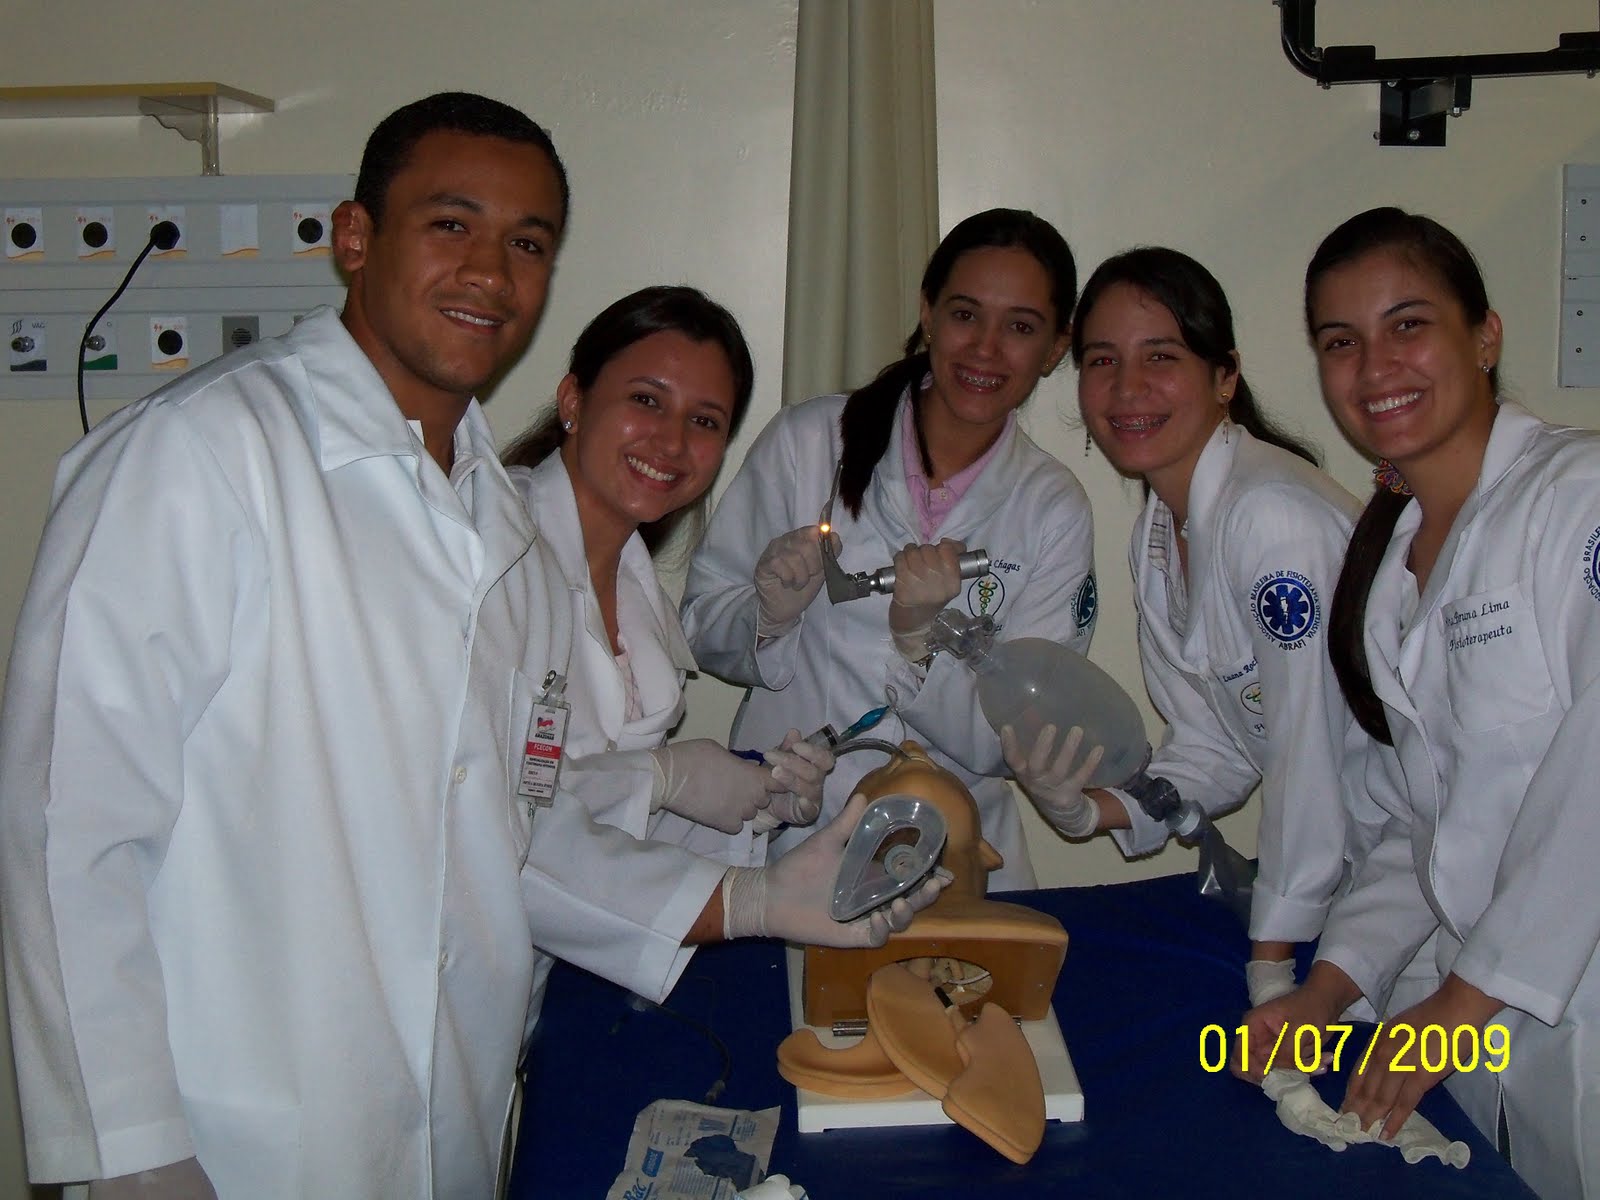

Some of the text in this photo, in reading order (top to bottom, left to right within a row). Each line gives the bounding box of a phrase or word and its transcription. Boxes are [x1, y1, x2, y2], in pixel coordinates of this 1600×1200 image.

[1583, 526, 1600, 562] BRASILE
[994, 559, 1021, 574] Chagas
[1251, 573, 1275, 600] BRASILEIRA
[1275, 570, 1284, 578] DE
[1481, 600, 1509, 617] Lima
[1278, 639, 1306, 651] ABRAFI
[1222, 671, 1244, 683] Luana
